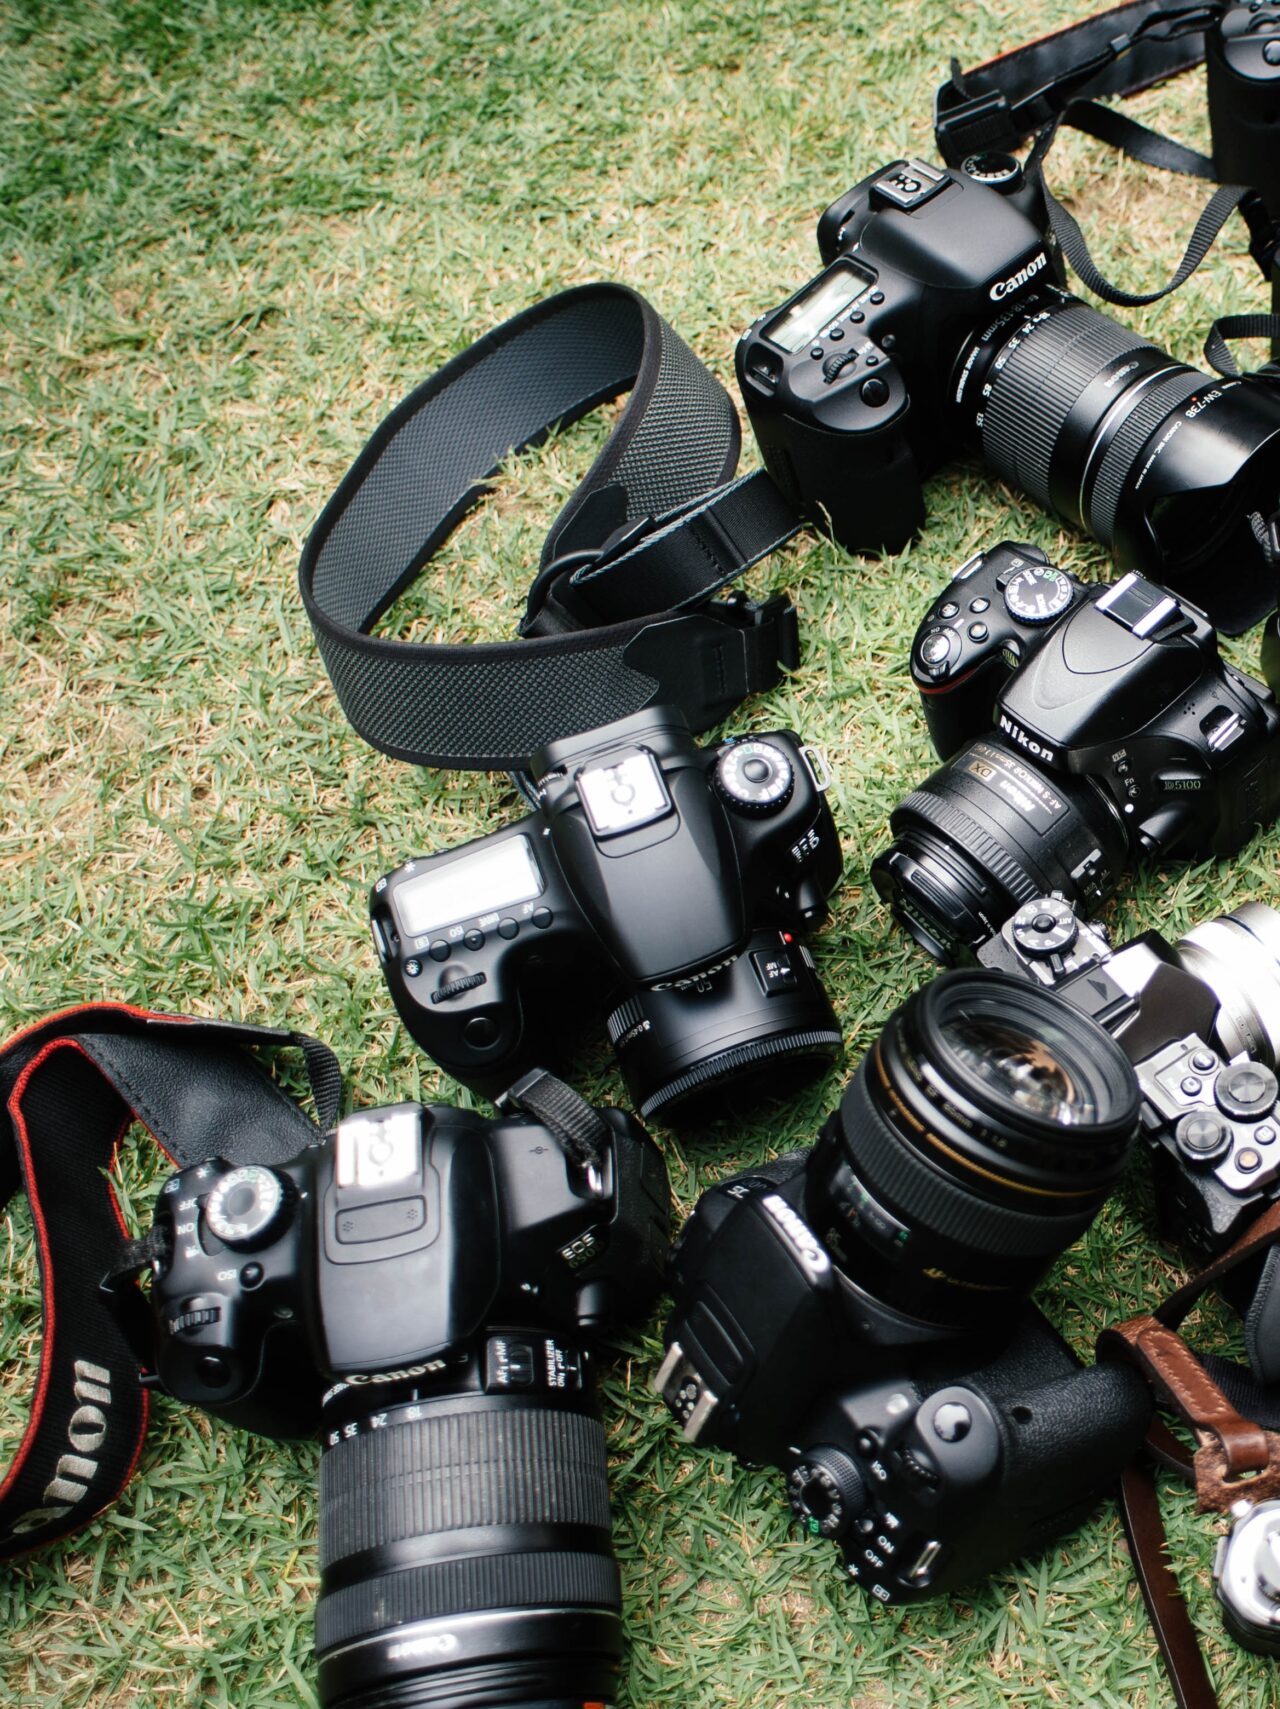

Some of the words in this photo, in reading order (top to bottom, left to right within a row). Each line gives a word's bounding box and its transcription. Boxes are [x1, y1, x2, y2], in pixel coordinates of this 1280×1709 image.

[989, 252, 1047, 301] Canon
[1022, 322, 1035, 334] 24
[1008, 337, 1021, 350] 35
[995, 357, 1006, 369] 50
[1104, 361, 1139, 388] Canon
[982, 383, 993, 397] 85
[1185, 389, 1223, 418] EW-73B
[1000, 714, 1054, 762] Nikon
[970, 761, 993, 778] DX
[650, 955, 738, 991] Canon
[177, 1223, 195, 1235] ON
[762, 1195, 831, 1273] Canon
[561, 1233, 595, 1260] EOS
[217, 1269, 237, 1281] ISO
[496, 1340, 507, 1356] MF
[346, 1358, 446, 1385] Canon
[545, 1339, 557, 1386] STABILIZER
[496, 1370, 508, 1383] AF
[557, 1372, 566, 1387] ON
[371, 1412, 388, 1428] 24
[344, 1422, 358, 1438] 35
[0, 1359, 111, 1544] anon
[872, 1460, 887, 1481] ISO
[877, 1535, 895, 1554] ON
[864, 1549, 884, 1568] OFF
